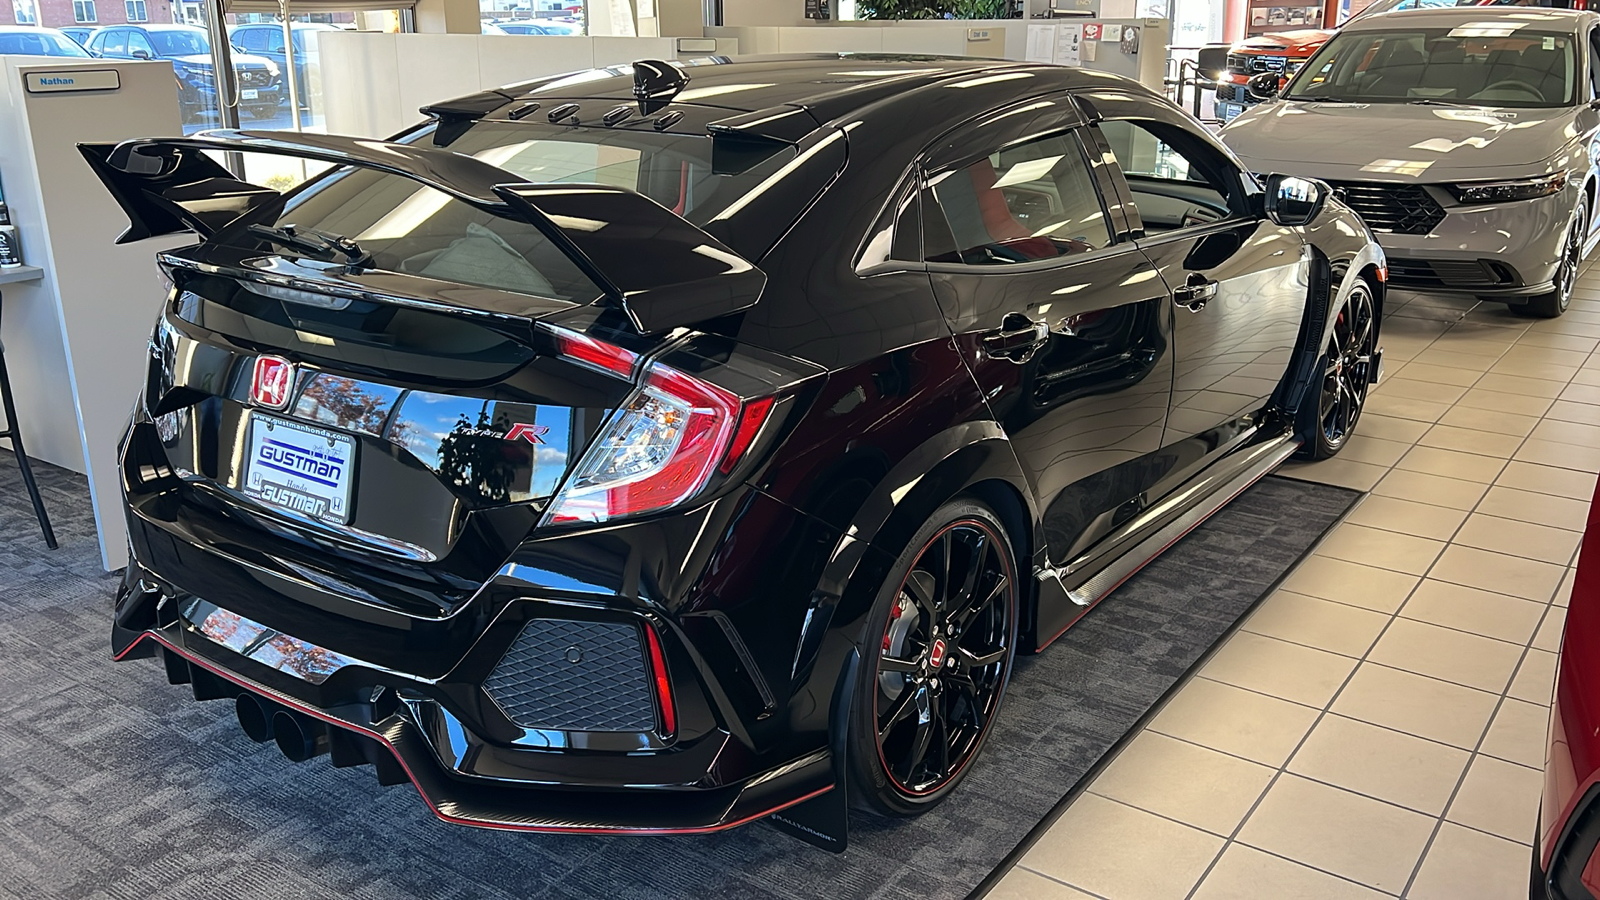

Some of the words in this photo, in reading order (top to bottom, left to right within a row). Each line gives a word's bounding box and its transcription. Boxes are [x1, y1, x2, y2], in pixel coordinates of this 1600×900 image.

[40, 77, 74, 86] Nathan
[252, 413, 350, 442] www.gustmanhonda.com
[503, 422, 550, 445] R
[243, 489, 262, 500] HONDA
[322, 513, 344, 525] HONDA
